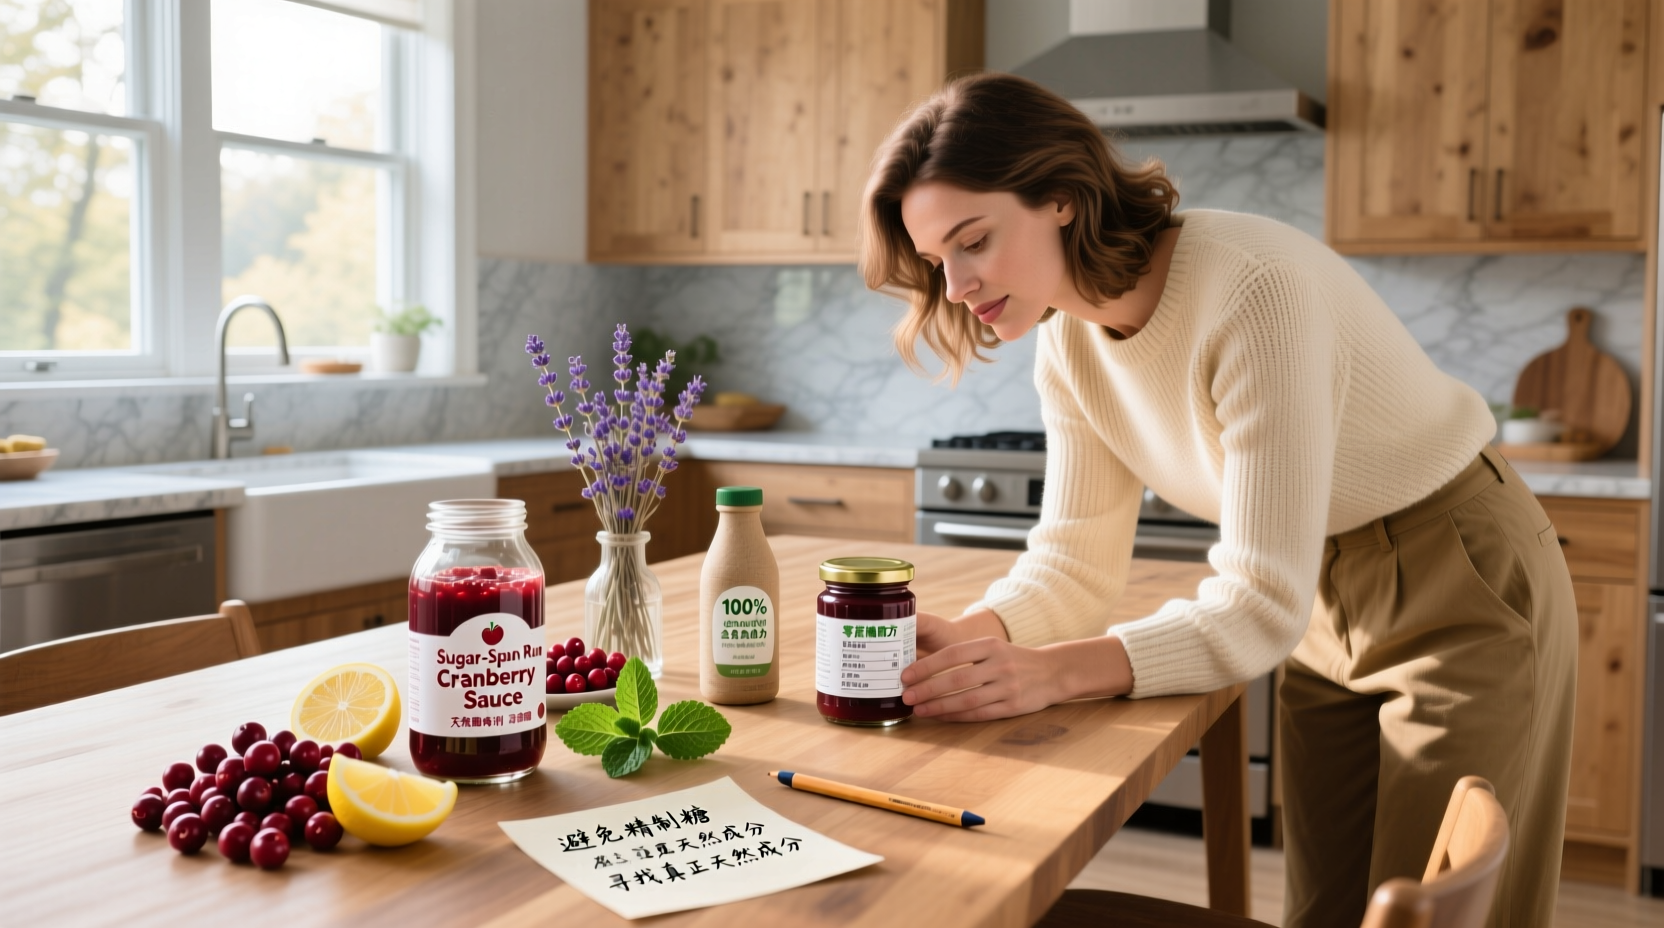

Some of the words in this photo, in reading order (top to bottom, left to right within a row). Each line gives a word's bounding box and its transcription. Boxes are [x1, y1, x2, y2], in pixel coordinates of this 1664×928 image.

[721, 598, 767, 615] 100%
[437, 666, 535, 688] Cranberry
[464, 690, 523, 709] Sauce
[557, 805, 710, 852] 避免精制糖
[609, 837, 803, 891] 寻找真正天然成分
